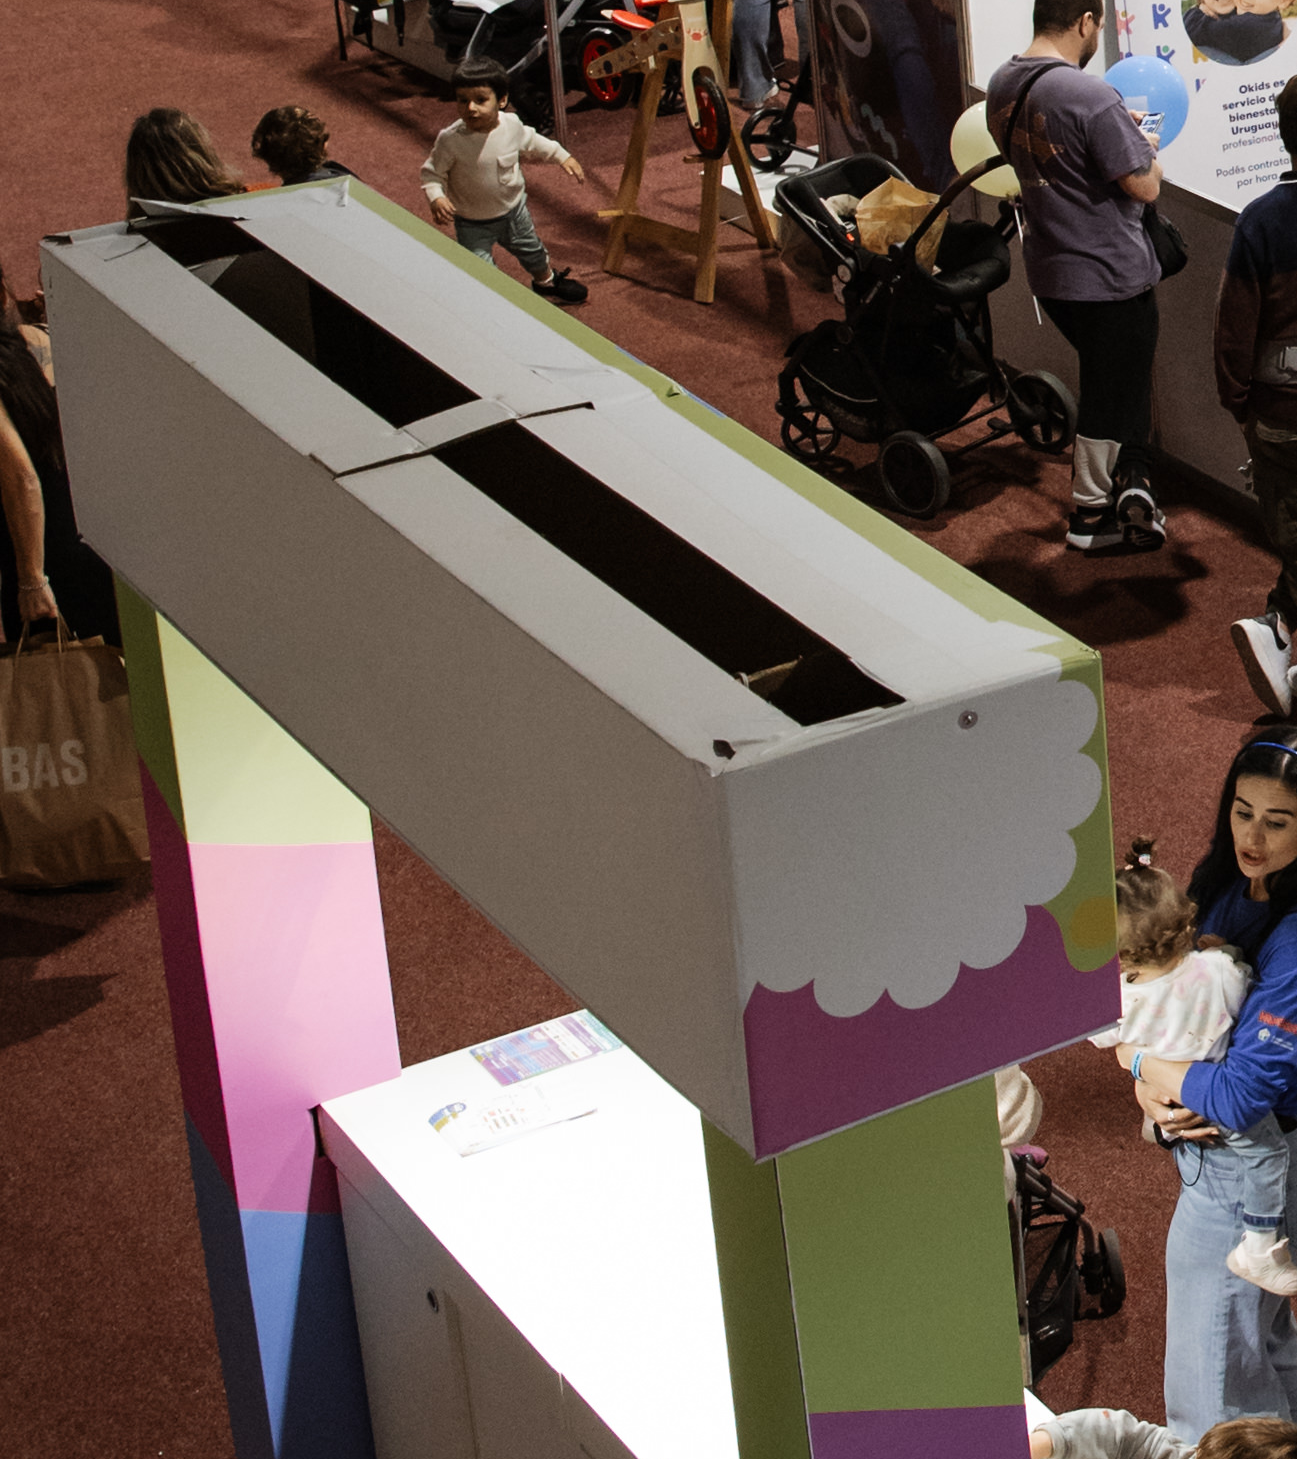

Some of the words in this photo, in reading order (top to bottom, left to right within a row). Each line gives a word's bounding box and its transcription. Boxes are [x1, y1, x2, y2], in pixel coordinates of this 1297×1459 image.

[1239, 81, 1270, 95] Okids
[1273, 79, 1285, 89] es
[1222, 95, 1266, 111] servicio
[1229, 106, 1278, 122] bienesta
[1222, 132, 1281, 152] profesionale
[1216, 165, 1246, 178] Podés
[1247, 156, 1291, 172] contrata
[1236, 175, 1253, 189] por
